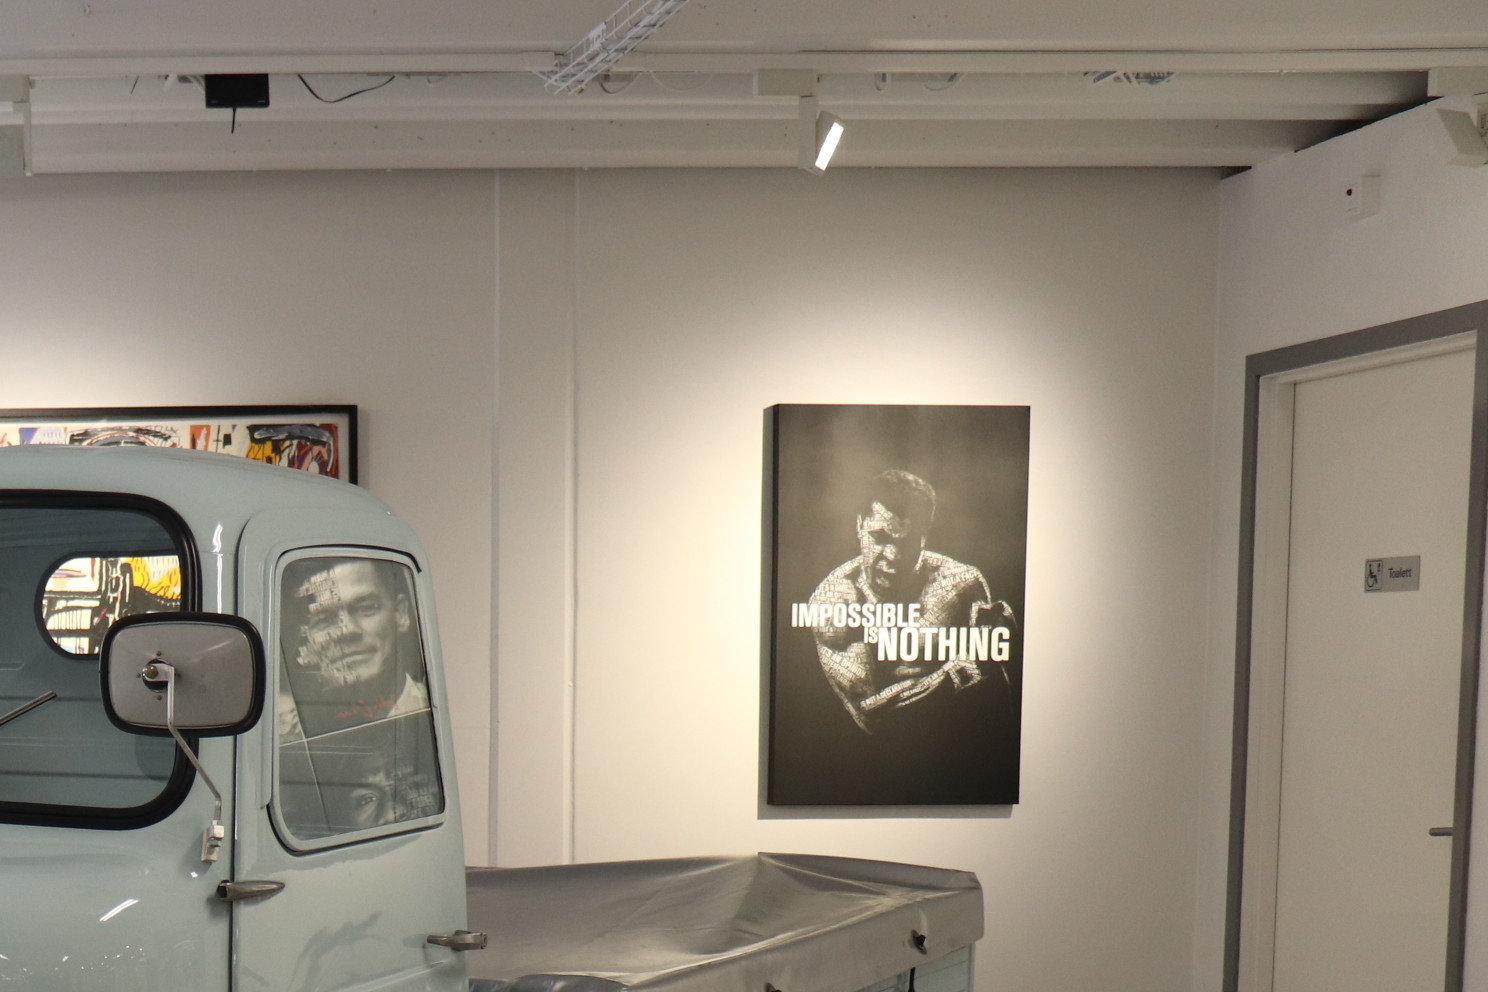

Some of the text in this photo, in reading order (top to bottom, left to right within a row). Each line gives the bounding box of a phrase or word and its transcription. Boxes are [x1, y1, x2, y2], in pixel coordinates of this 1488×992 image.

[792, 603, 920, 627] IMPOSSIBLE
[864, 627, 1010, 661] IS NOTHING
